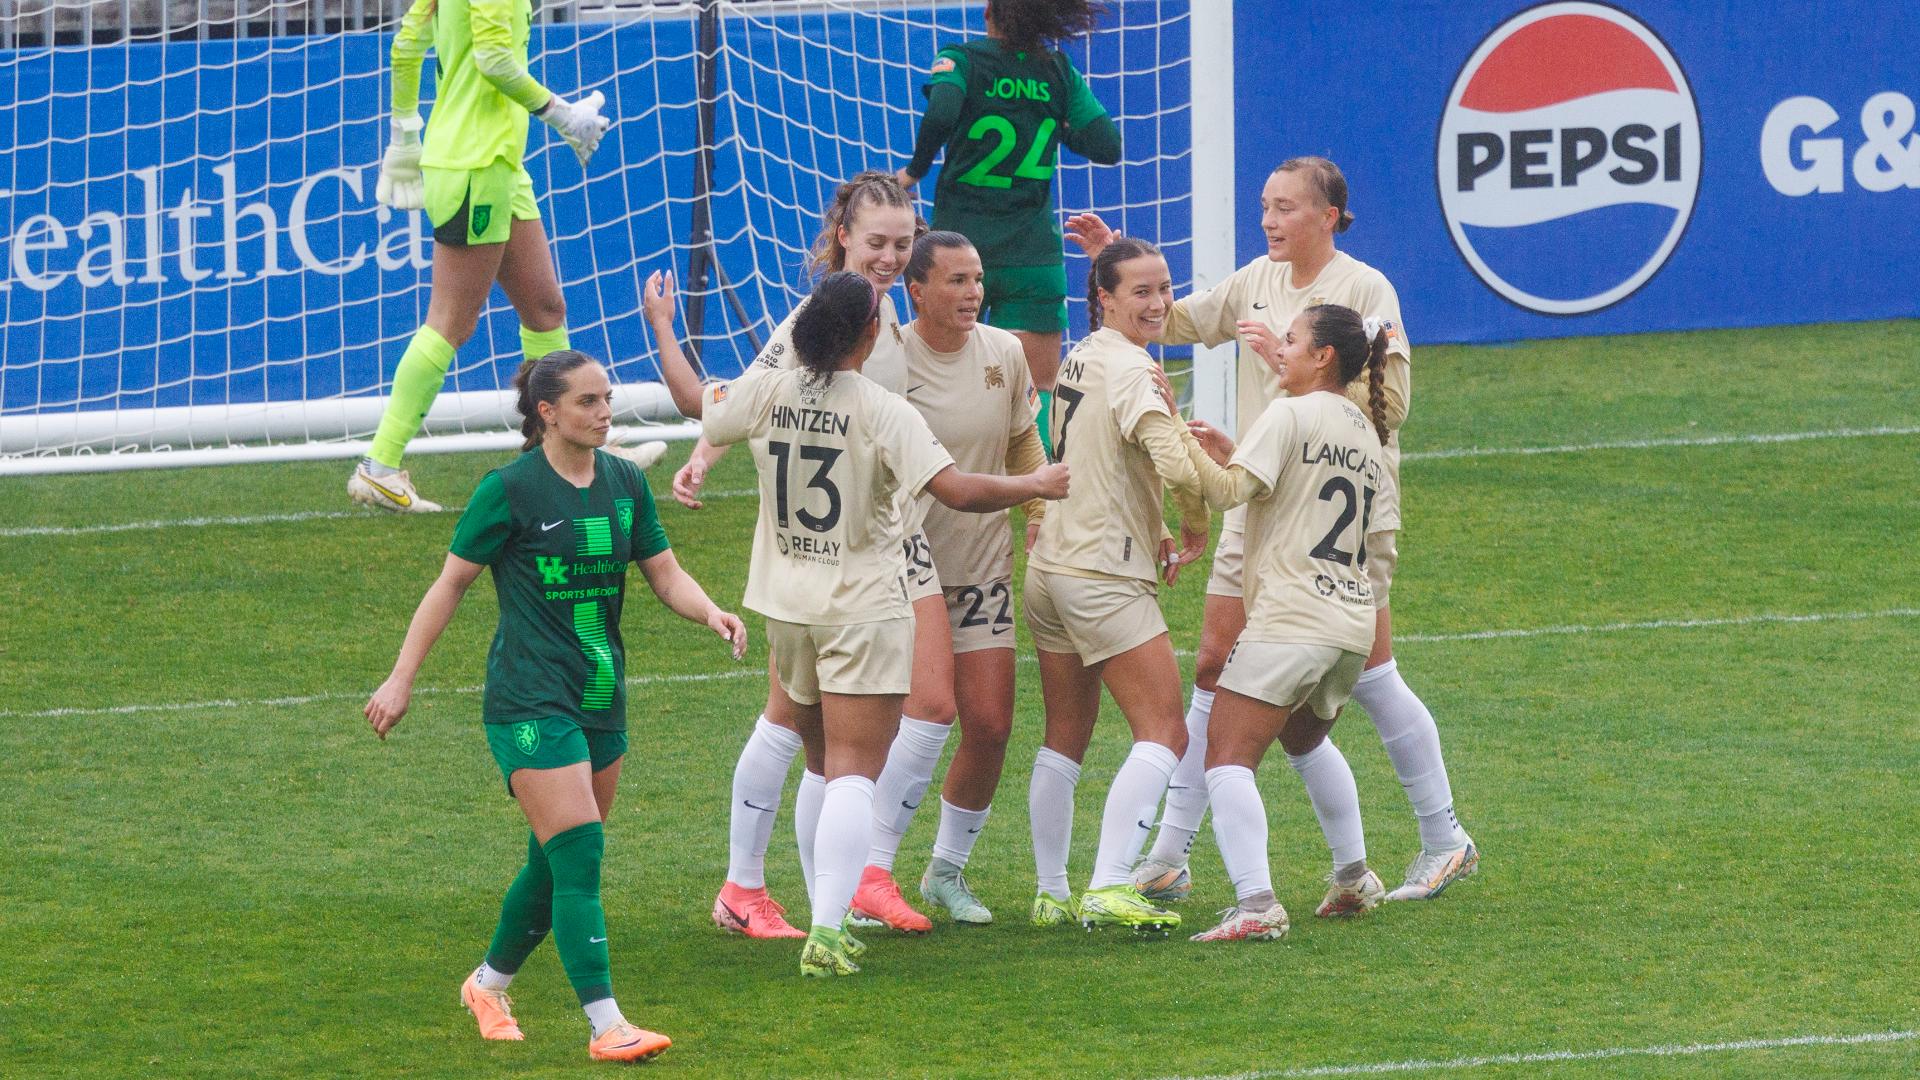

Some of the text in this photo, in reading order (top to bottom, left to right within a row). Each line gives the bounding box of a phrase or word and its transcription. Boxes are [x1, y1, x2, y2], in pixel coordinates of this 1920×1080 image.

[957, 114, 1057, 189] 24
[1457, 122, 1681, 192] PEPSI
[1760, 91, 1920, 197] G&
[0, 161, 434, 291] ealthCa
[771, 405, 850, 437] HINTZEN
[768, 440, 845, 533] 13
[792, 536, 841, 557] RELAY
[818, 557, 840, 567] CLOUD
[545, 590, 585, 600] SPORTS
[957, 583, 1013, 628] 22
